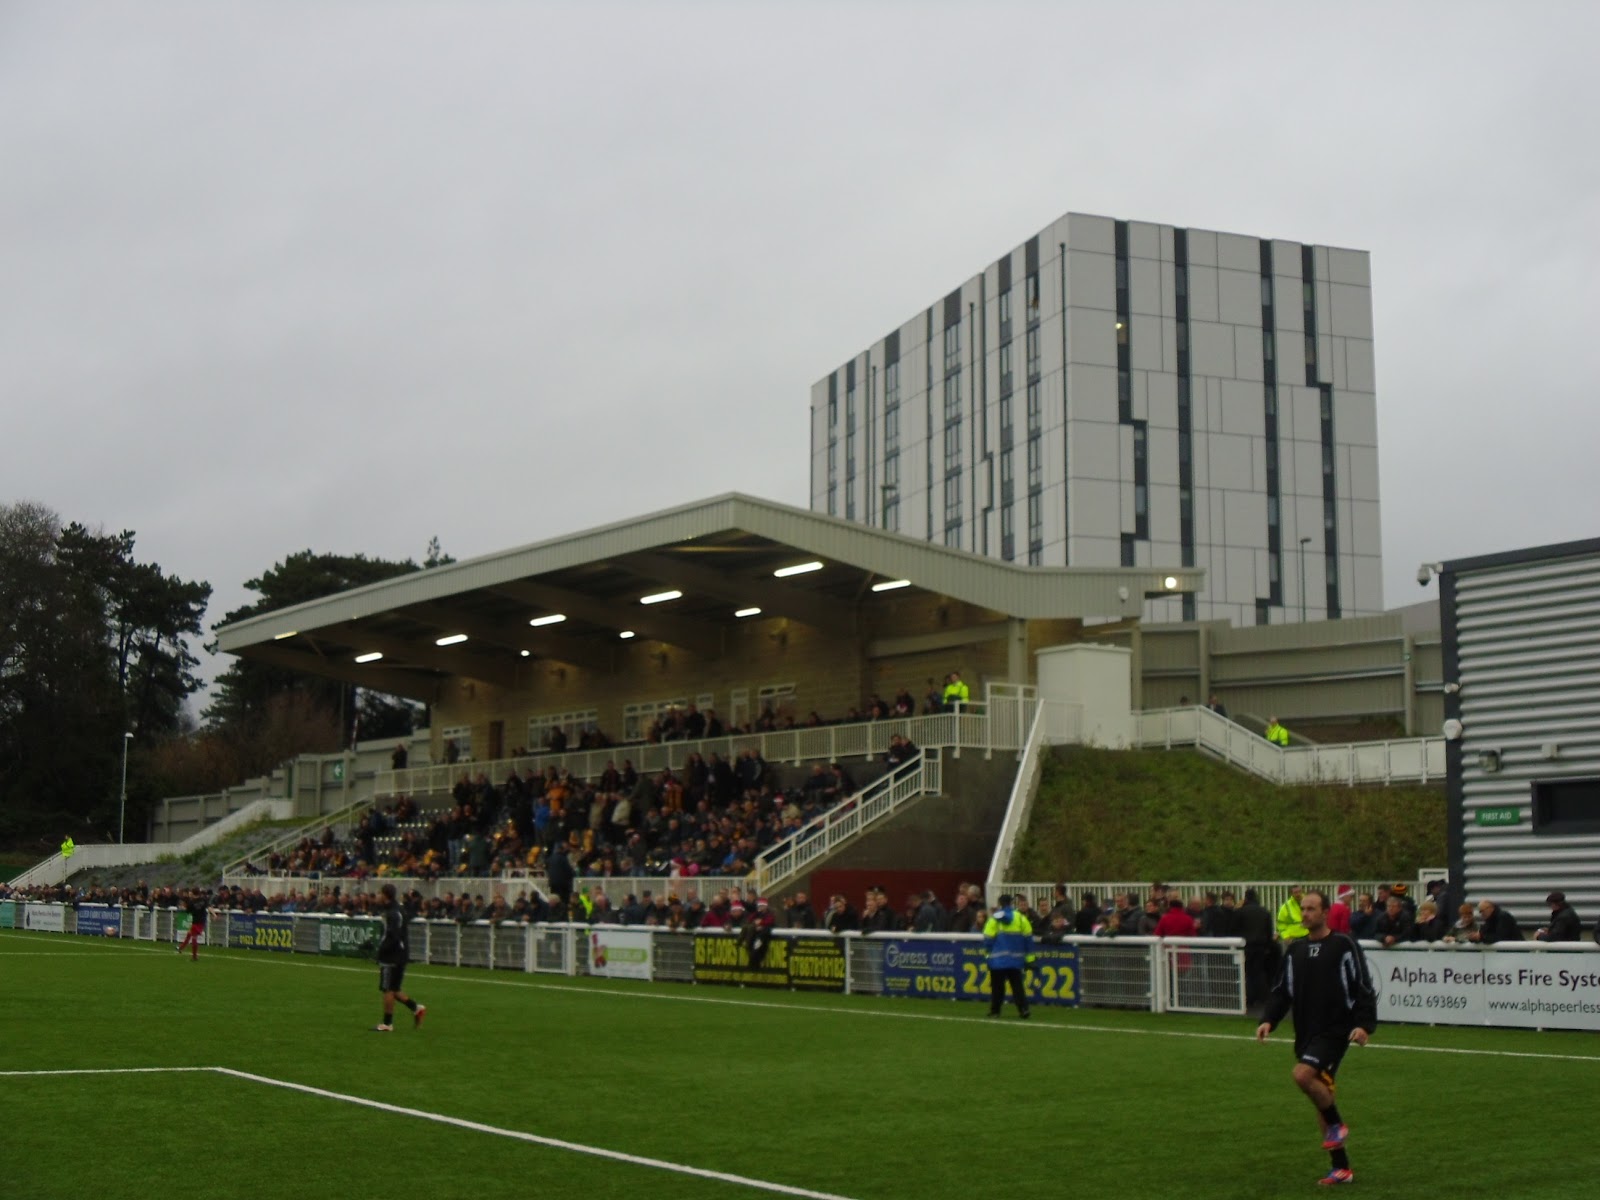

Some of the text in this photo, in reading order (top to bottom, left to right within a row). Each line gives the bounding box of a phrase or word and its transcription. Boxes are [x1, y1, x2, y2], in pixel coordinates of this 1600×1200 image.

[1482, 811, 1512, 820] FIRST AID
[1309, 946, 1321, 958] 12
[931, 953, 955, 966] cars
[915, 975, 956, 993] 01622
[1390, 967, 1600, 991] Alpha Peerless Fire Syst
[1390, 994, 1423, 1008] 01622
[1426, 995, 1468, 1009] 693869
